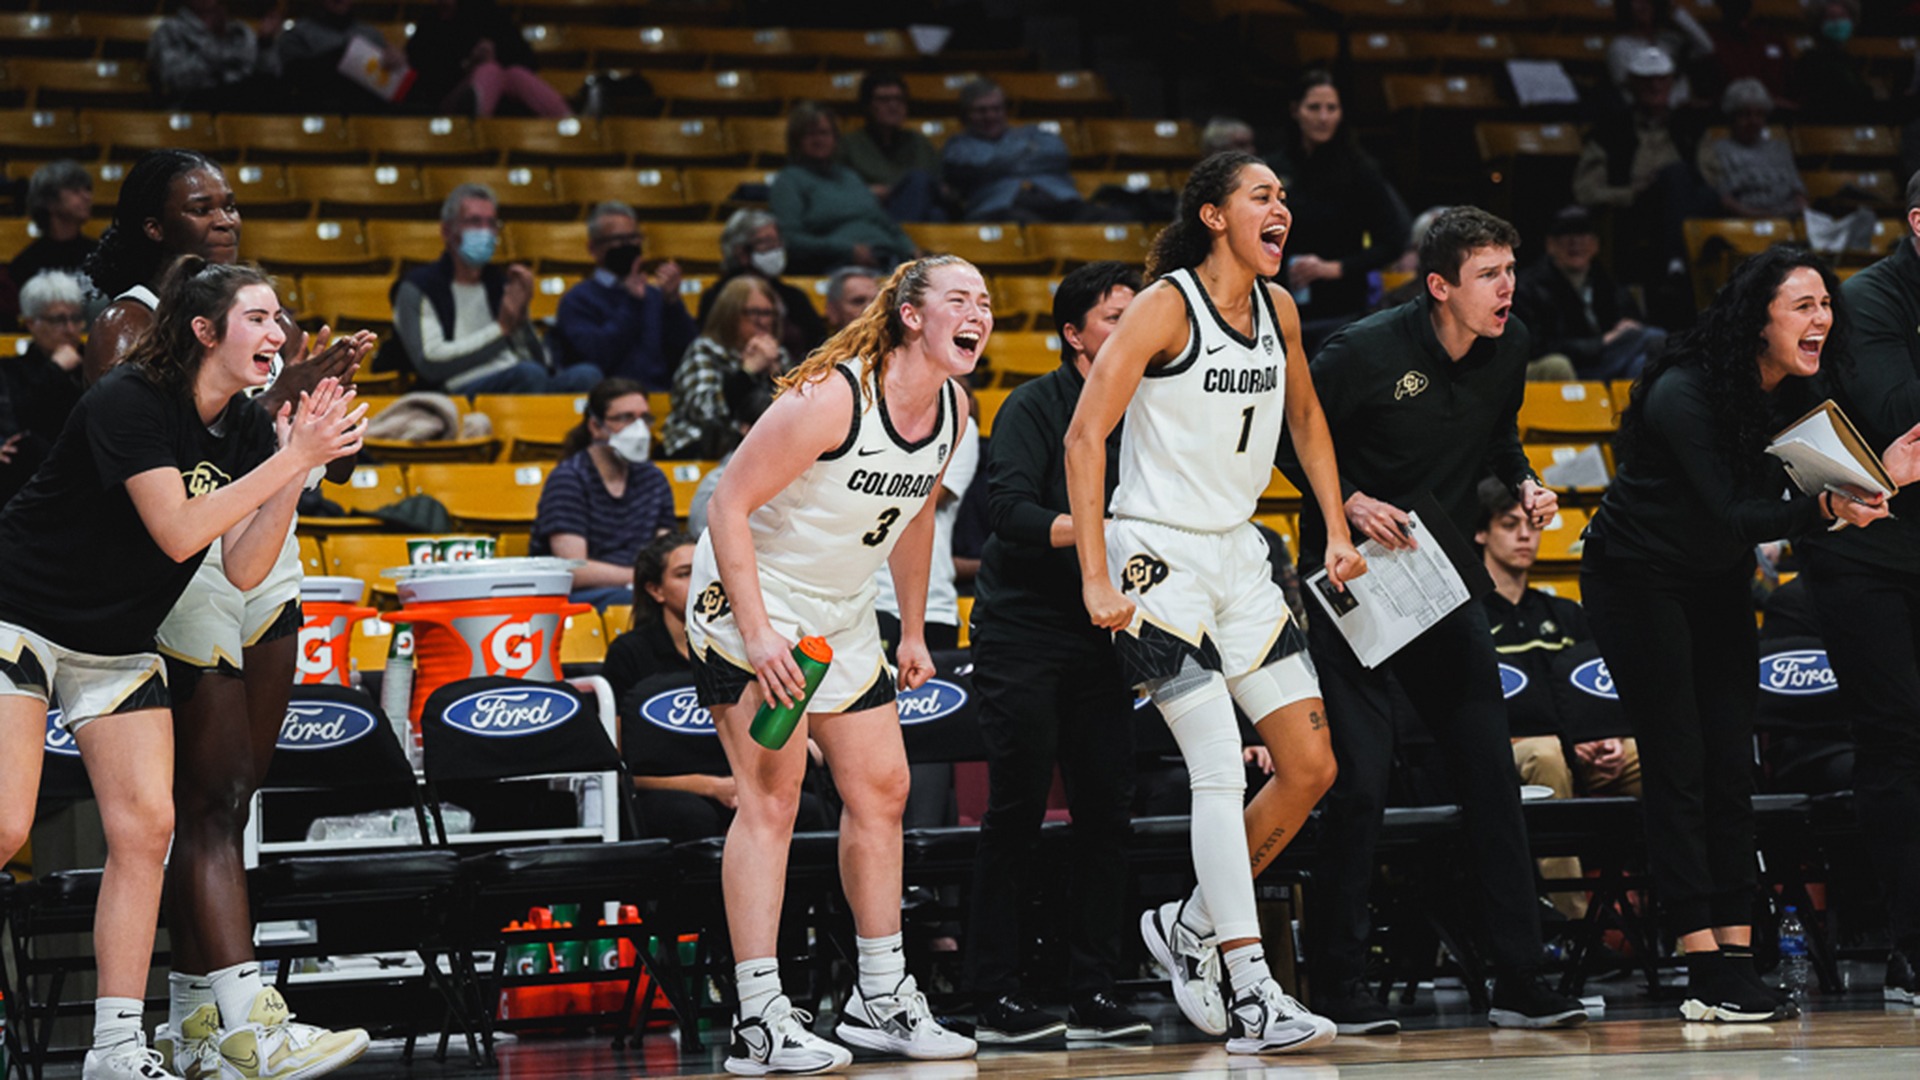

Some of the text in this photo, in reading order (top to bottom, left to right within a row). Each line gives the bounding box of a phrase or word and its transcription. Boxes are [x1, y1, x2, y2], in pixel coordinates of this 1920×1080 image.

[1235, 404, 1256, 455] 1
[847, 468, 940, 498] COLORAD
[862, 506, 902, 547] 3
[296, 626, 333, 675] G
[491, 622, 533, 671] G
[470, 693, 552, 729] Ford
[667, 692, 717, 726] Fo
